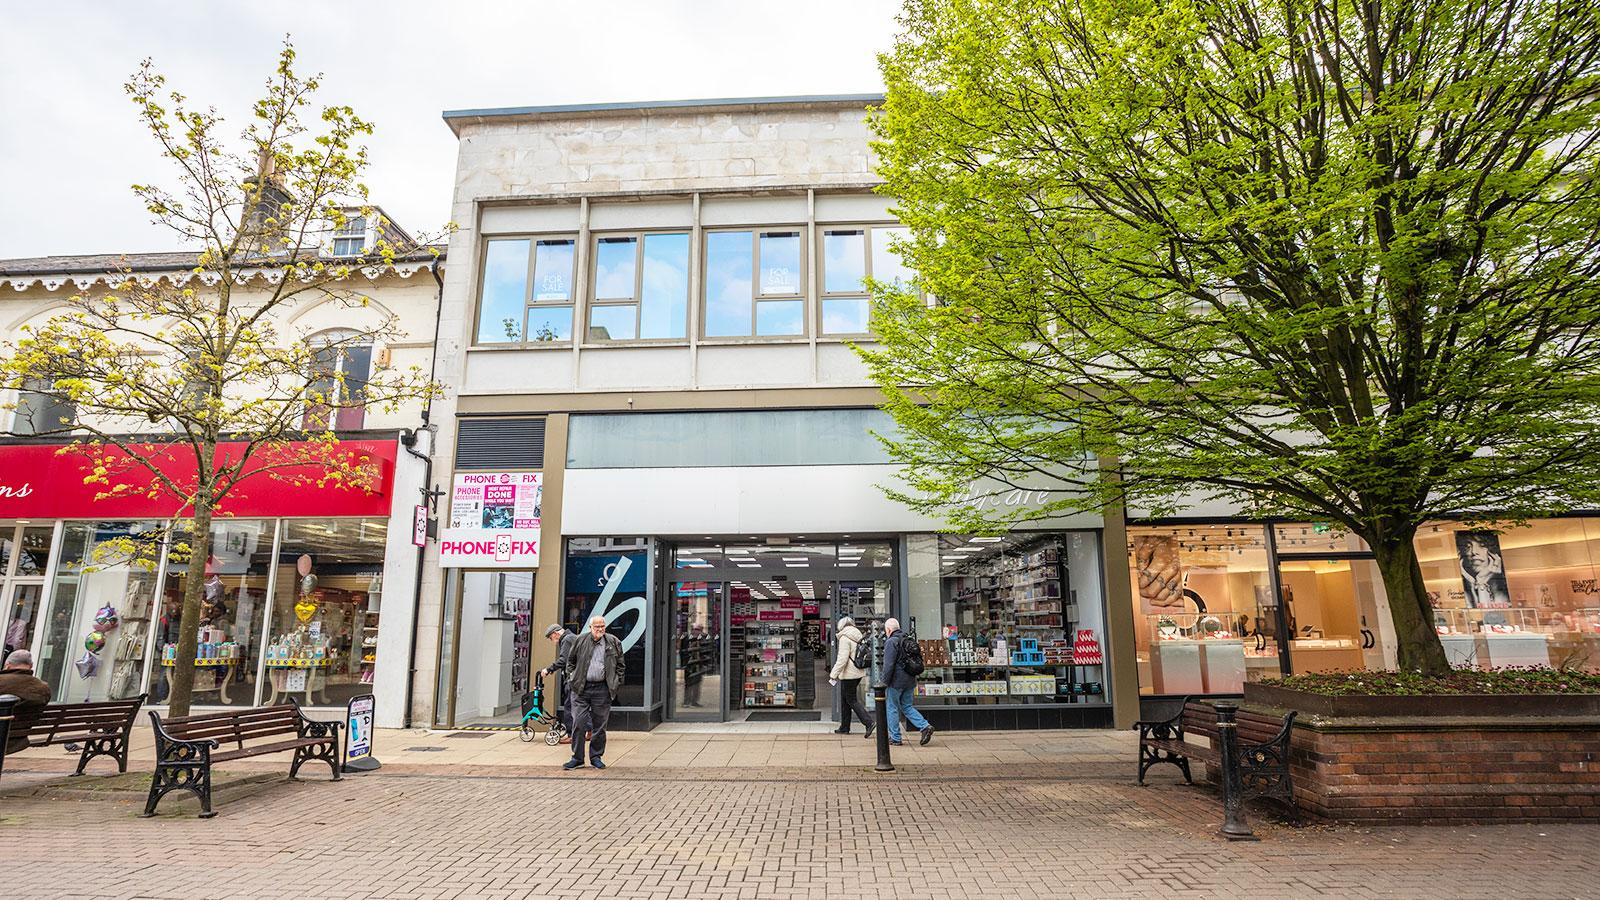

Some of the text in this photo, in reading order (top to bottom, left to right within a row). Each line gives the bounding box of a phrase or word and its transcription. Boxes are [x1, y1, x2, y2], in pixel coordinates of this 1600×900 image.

[543, 274, 562, 283] FOR
[542, 282, 564, 292] SALE
[464, 475, 497, 484] PHONE
[522, 474, 538, 483] FIX
[456, 487, 481, 495] PHONE
[487, 491, 512, 499] DONE
[441, 541, 537, 555] PHONE FIX
